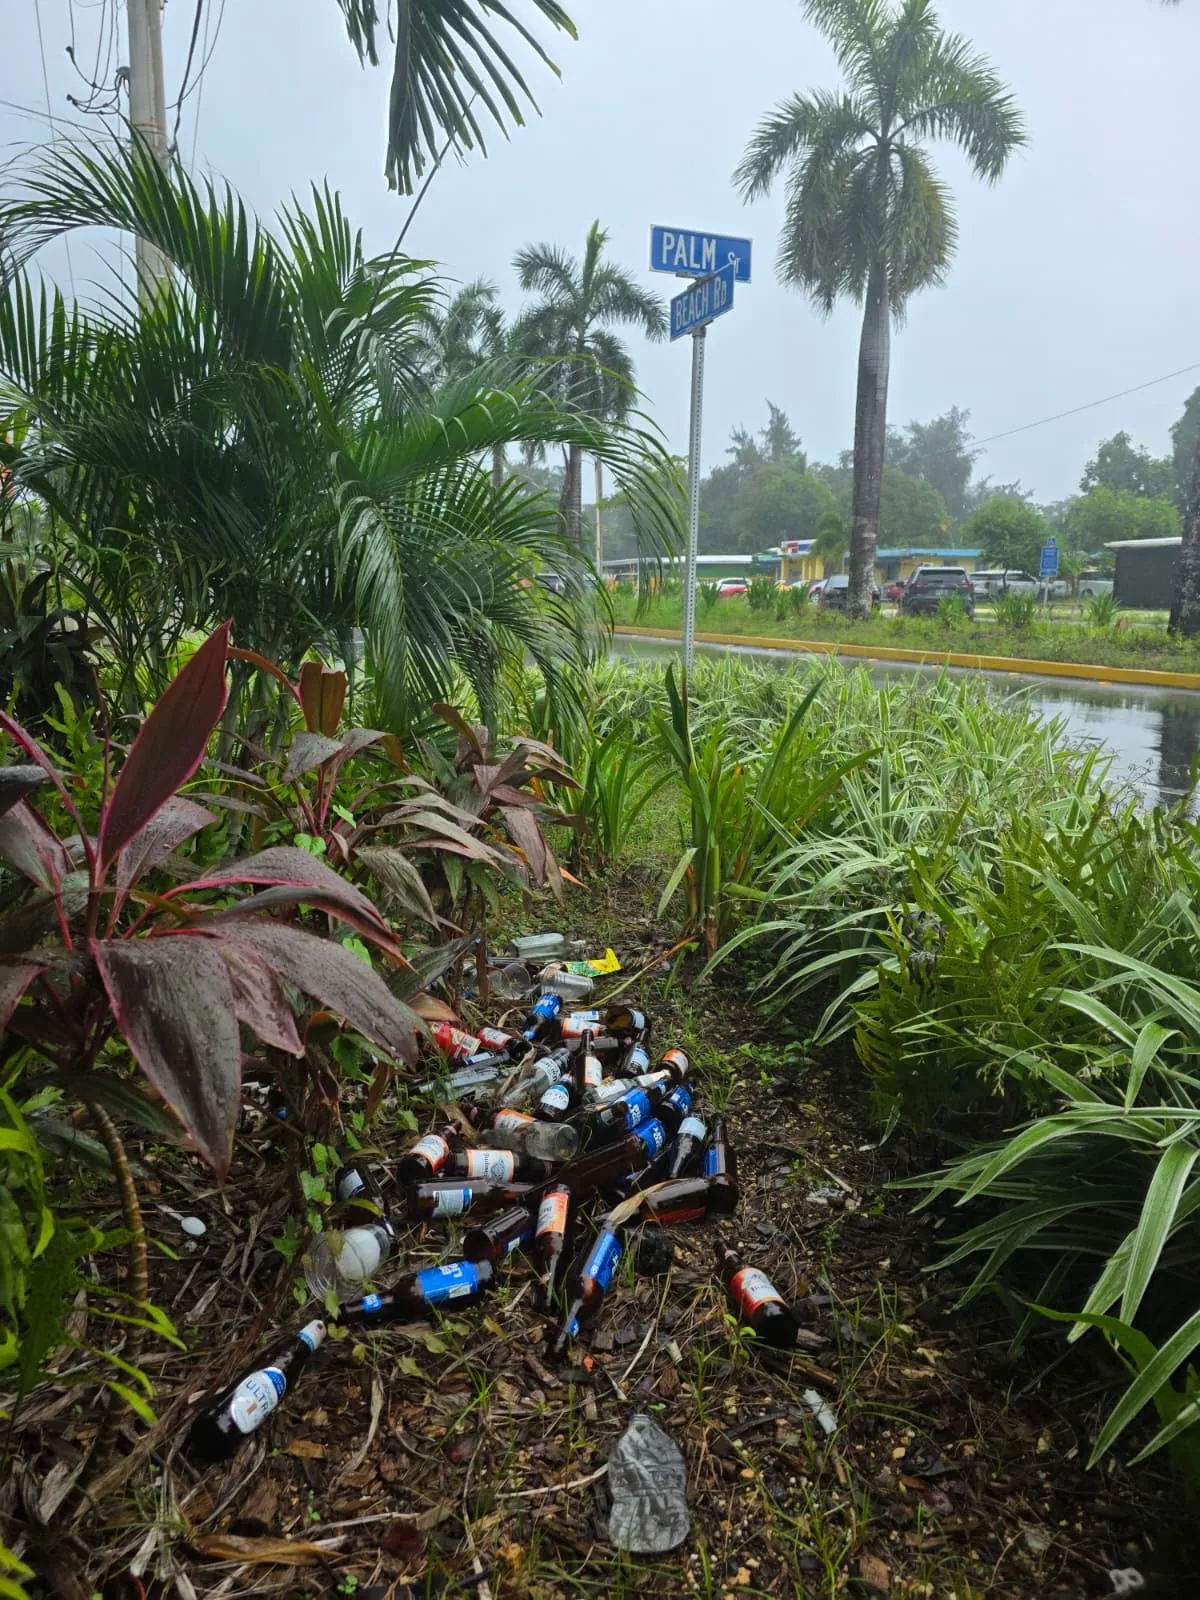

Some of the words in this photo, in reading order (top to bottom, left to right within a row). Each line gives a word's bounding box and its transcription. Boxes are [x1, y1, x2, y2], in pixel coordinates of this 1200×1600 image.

[662, 232, 717, 270] PALM
[675, 283, 709, 330] BEACH
[713, 277, 727, 309] RD
[246, 1380, 268, 1411] ULTR
